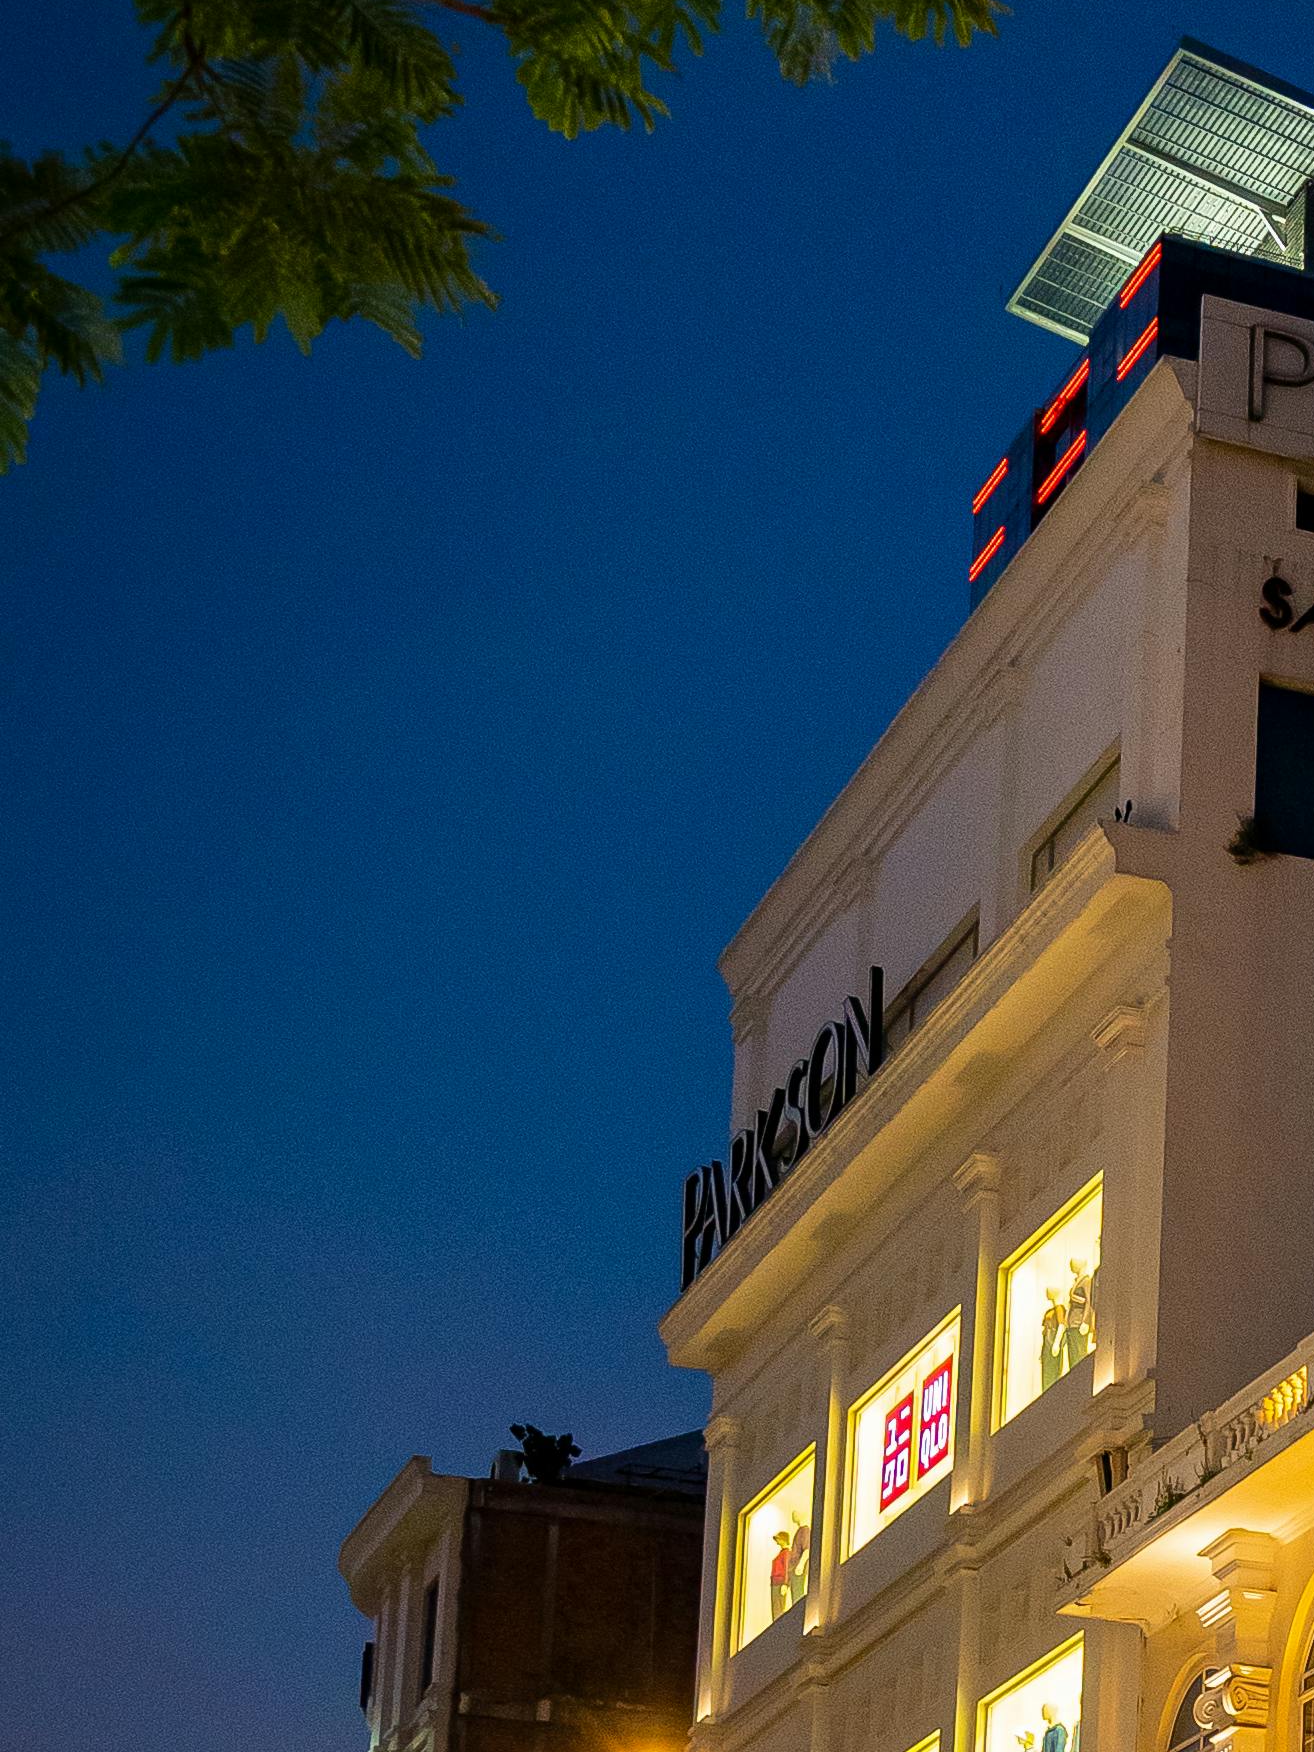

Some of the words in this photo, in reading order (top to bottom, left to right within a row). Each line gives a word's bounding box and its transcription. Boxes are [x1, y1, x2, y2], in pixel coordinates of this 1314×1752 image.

[680, 964, 885, 1294] PARKSON
[923, 1370, 949, 1423] UNI
[920, 1413, 948, 1469] QLO
